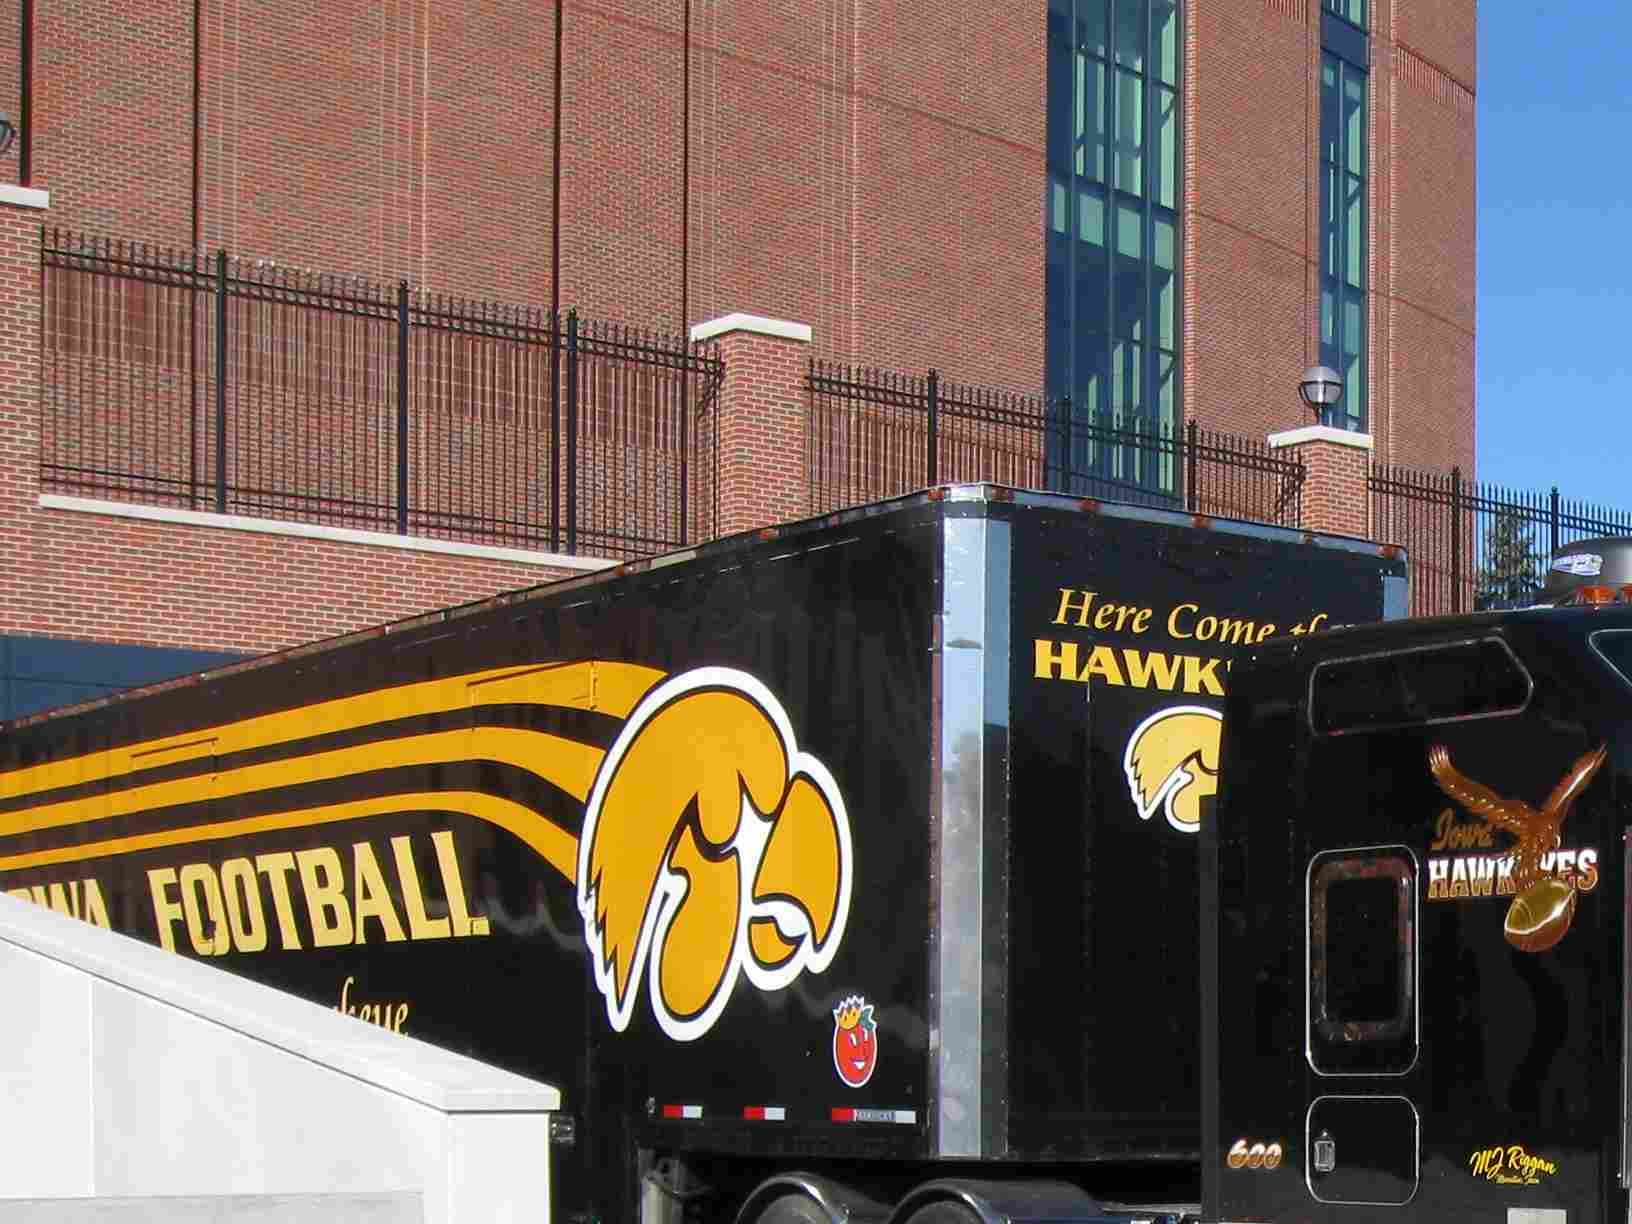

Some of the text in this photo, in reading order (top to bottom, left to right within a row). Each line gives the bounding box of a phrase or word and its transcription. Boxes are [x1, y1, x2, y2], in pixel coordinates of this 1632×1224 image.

[1051, 588, 1153, 634] Here
[1167, 604, 1276, 645] Come
[1032, 638, 1233, 697] HAWK
[146, 831, 491, 958] FOOTBALL
[1427, 849, 1599, 899] HAWKYES
[1227, 1139, 1283, 1169] 600
[1469, 1146, 1556, 1180] MJ Riggan
